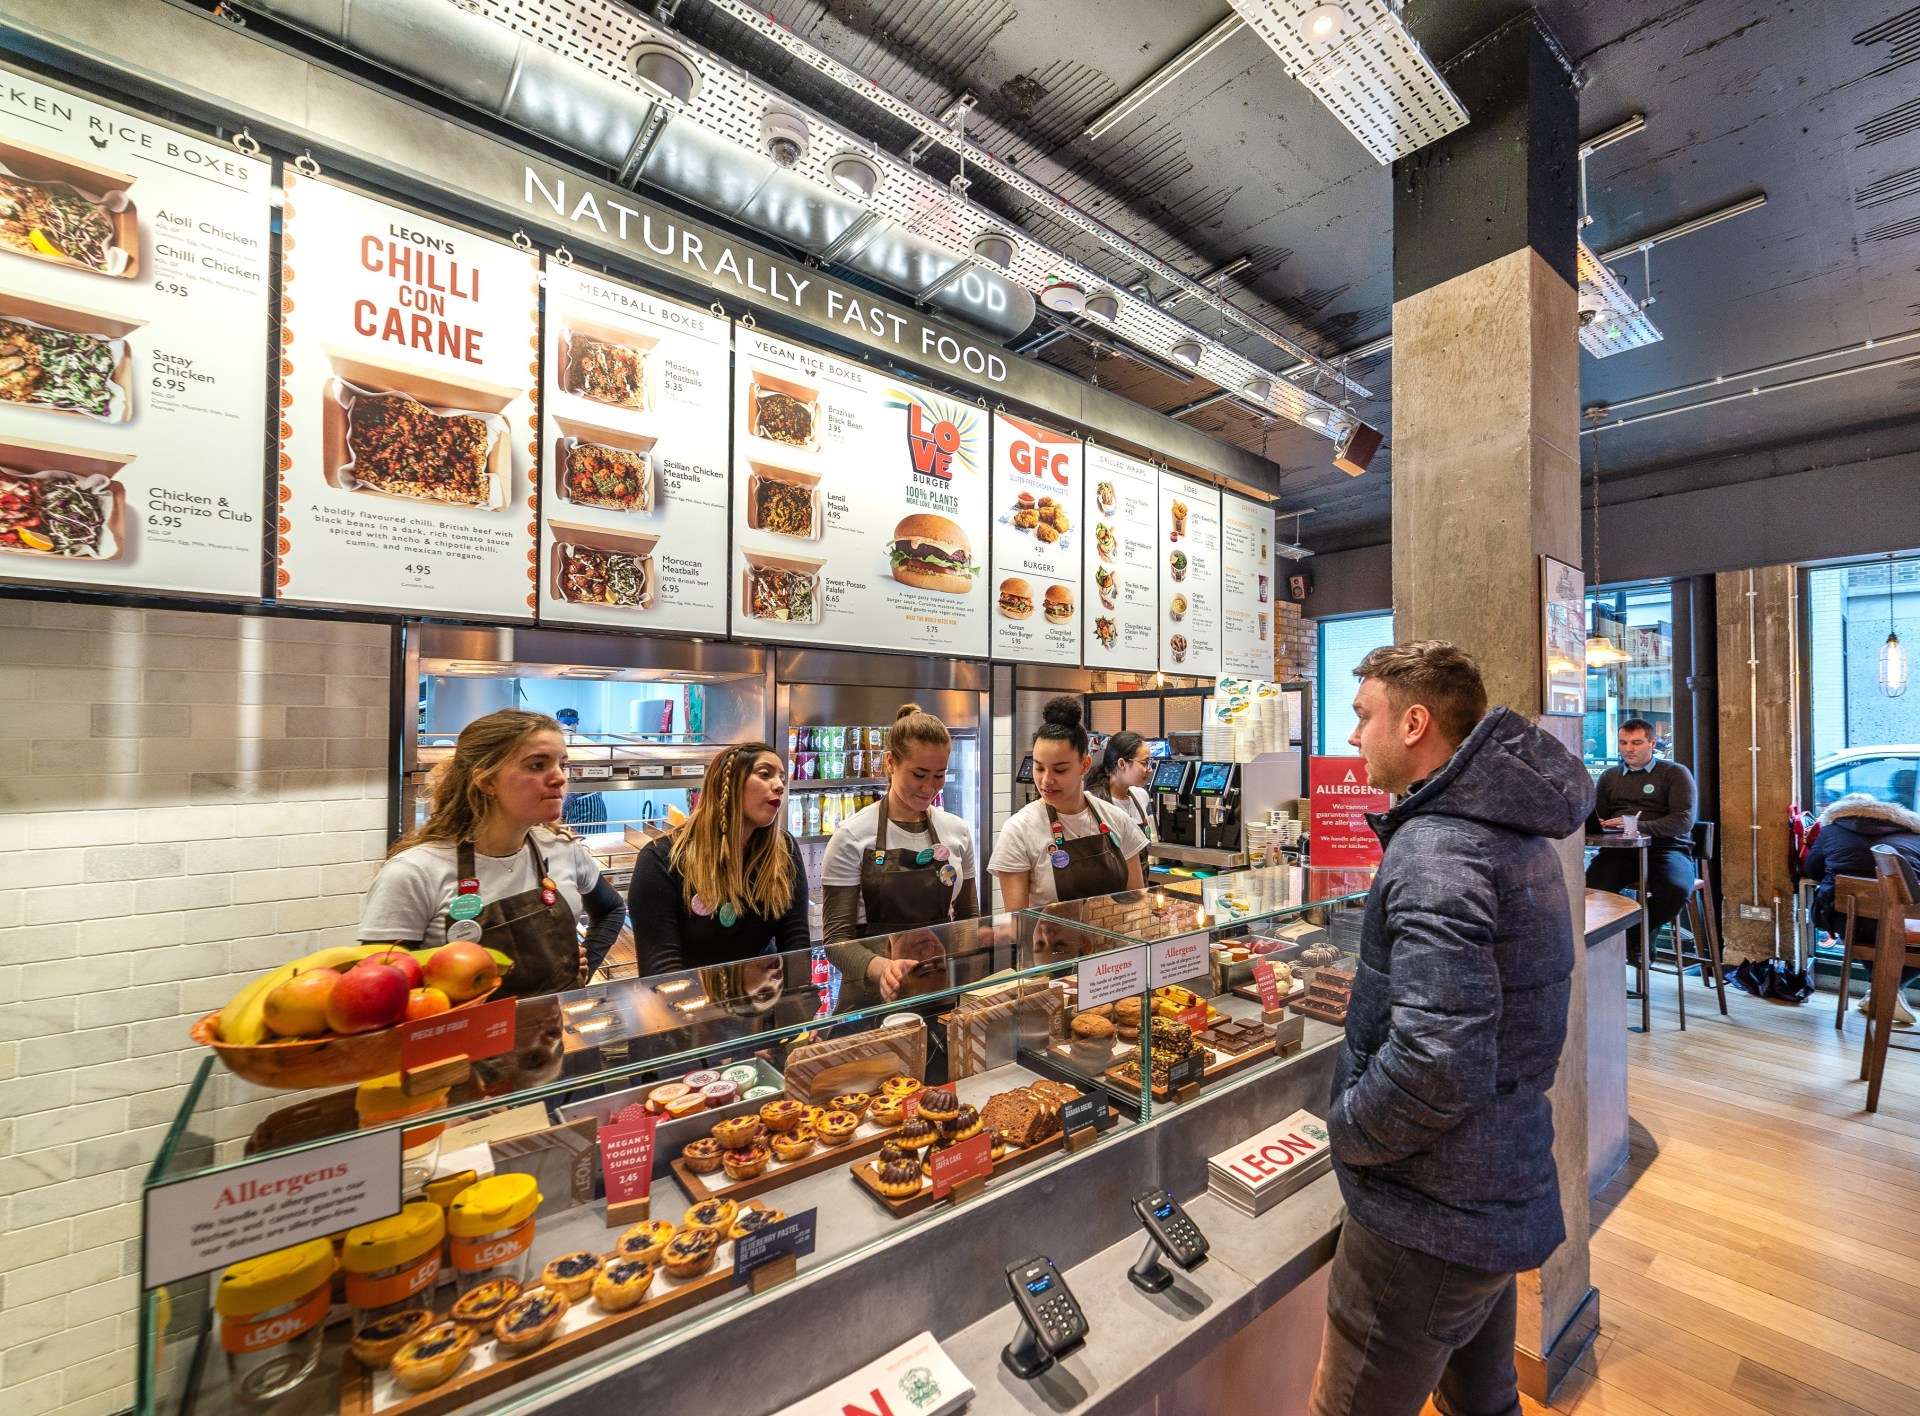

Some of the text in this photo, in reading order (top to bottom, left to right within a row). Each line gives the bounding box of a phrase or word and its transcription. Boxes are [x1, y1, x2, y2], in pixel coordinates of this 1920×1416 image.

[0, 83, 248, 180] KEN RICE BOXES
[156, 210, 192, 228] Aioli
[199, 222, 258, 248] Chicken
[389, 224, 455, 255] LEON'S
[156, 244, 195, 263] Chilli
[202, 257, 260, 281] Chicken
[361, 235, 479, 303] CHILLI
[525, 166, 1006, 383] NATURALLY FAST FOOD
[155, 281, 188, 297] 6.95
[399, 285, 445, 317] CON
[579, 282, 705, 331] MEATBALL BOXES
[354, 299, 484, 366] CARNE
[152, 349, 193, 368] Satay
[755, 339, 862, 383] VEGAN RICE BOXES
[152, 362, 215, 384] Chicken
[665, 360, 700, 376] Meatless
[152, 377, 186, 392] 6.95
[665, 370, 702, 387] Meatballs
[665, 380, 683, 391] 5.35
[829, 424, 842, 433] 3.95
[664, 459, 724, 479] Sicilian Chicken
[1009, 440, 1069, 486] GFC
[1099, 456, 1124, 469] GRILLED
[664, 468, 701, 483] Meatballs
[664, 479, 681, 489] 5.65
[913, 474, 950, 490] BURGER
[149, 487, 229, 507] Chicken &
[827, 492, 846, 502] Lentil
[906, 485, 928, 500] 100%
[930, 491, 958, 508] PLANTS
[1184, 484, 1198, 495] SIDES
[149, 500, 252, 522] Chorizo Club
[827, 501, 849, 512] Masala
[827, 511, 841, 519] 4.95
[148, 515, 182, 528] 6.95
[315, 515, 342, 525] black
[347, 519, 375, 529] beans
[430, 530, 448, 538] rich
[452, 533, 483, 542] tomato
[324, 506, 355, 518] boldly
[360, 511, 406, 524] flavoured
[439, 522, 469, 532] British
[473, 527, 492, 535] beef
[329, 528, 362, 537] spiced
[366, 532, 388, 540] with
[392, 535, 420, 544] ancho
[435, 540, 471, 550] chipotle
[404, 546, 442, 555] mexican
[446, 551, 485, 560] oregano.
[662, 555, 702, 568] Moroccan
[405, 564, 431, 575] 4.95
[662, 565, 700, 576] Meatballs
[1023, 560, 1055, 573] BURGERS
[661, 584, 680, 593] 6.95
[826, 577, 867, 589] Sweet Potato
[826, 585, 845, 594] Falafel
[999, 629, 1033, 639] Chicken Burger
[1165, 943, 1197, 959] Allergens
[1095, 959, 1132, 977] Allergens
[410, 1019, 470, 1041] PIECE OF FRUIT
[607, 1135, 650, 1150] MEGAN'S
[606, 1144, 652, 1160] YOGHURT
[950, 1152, 963, 1164] CAKE
[1228, 1132, 1317, 1183] LEON
[610, 1155, 648, 1169] SUNDAE
[213, 1162, 349, 1210] Allergens
[619, 1172, 638, 1185] 2.45
[191, 1221, 214, 1233] We
[218, 1209, 259, 1226] handle
[279, 1189, 329, 1210] allergens
[332, 1185, 343, 1195] in
[345, 1179, 367, 1191] our
[190, 1191, 367, 1247] kitchen and cannot guarantee
[226, 1232, 263, 1250] dishes
[740, 1232, 777, 1254] BLUEBERRY
[777, 1223, 800, 1239] PASTEL
[474, 1241, 522, 1265] LEON.
[749, 1244, 767, 1258] NATA
[244, 1317, 307, 1347] LEON.
